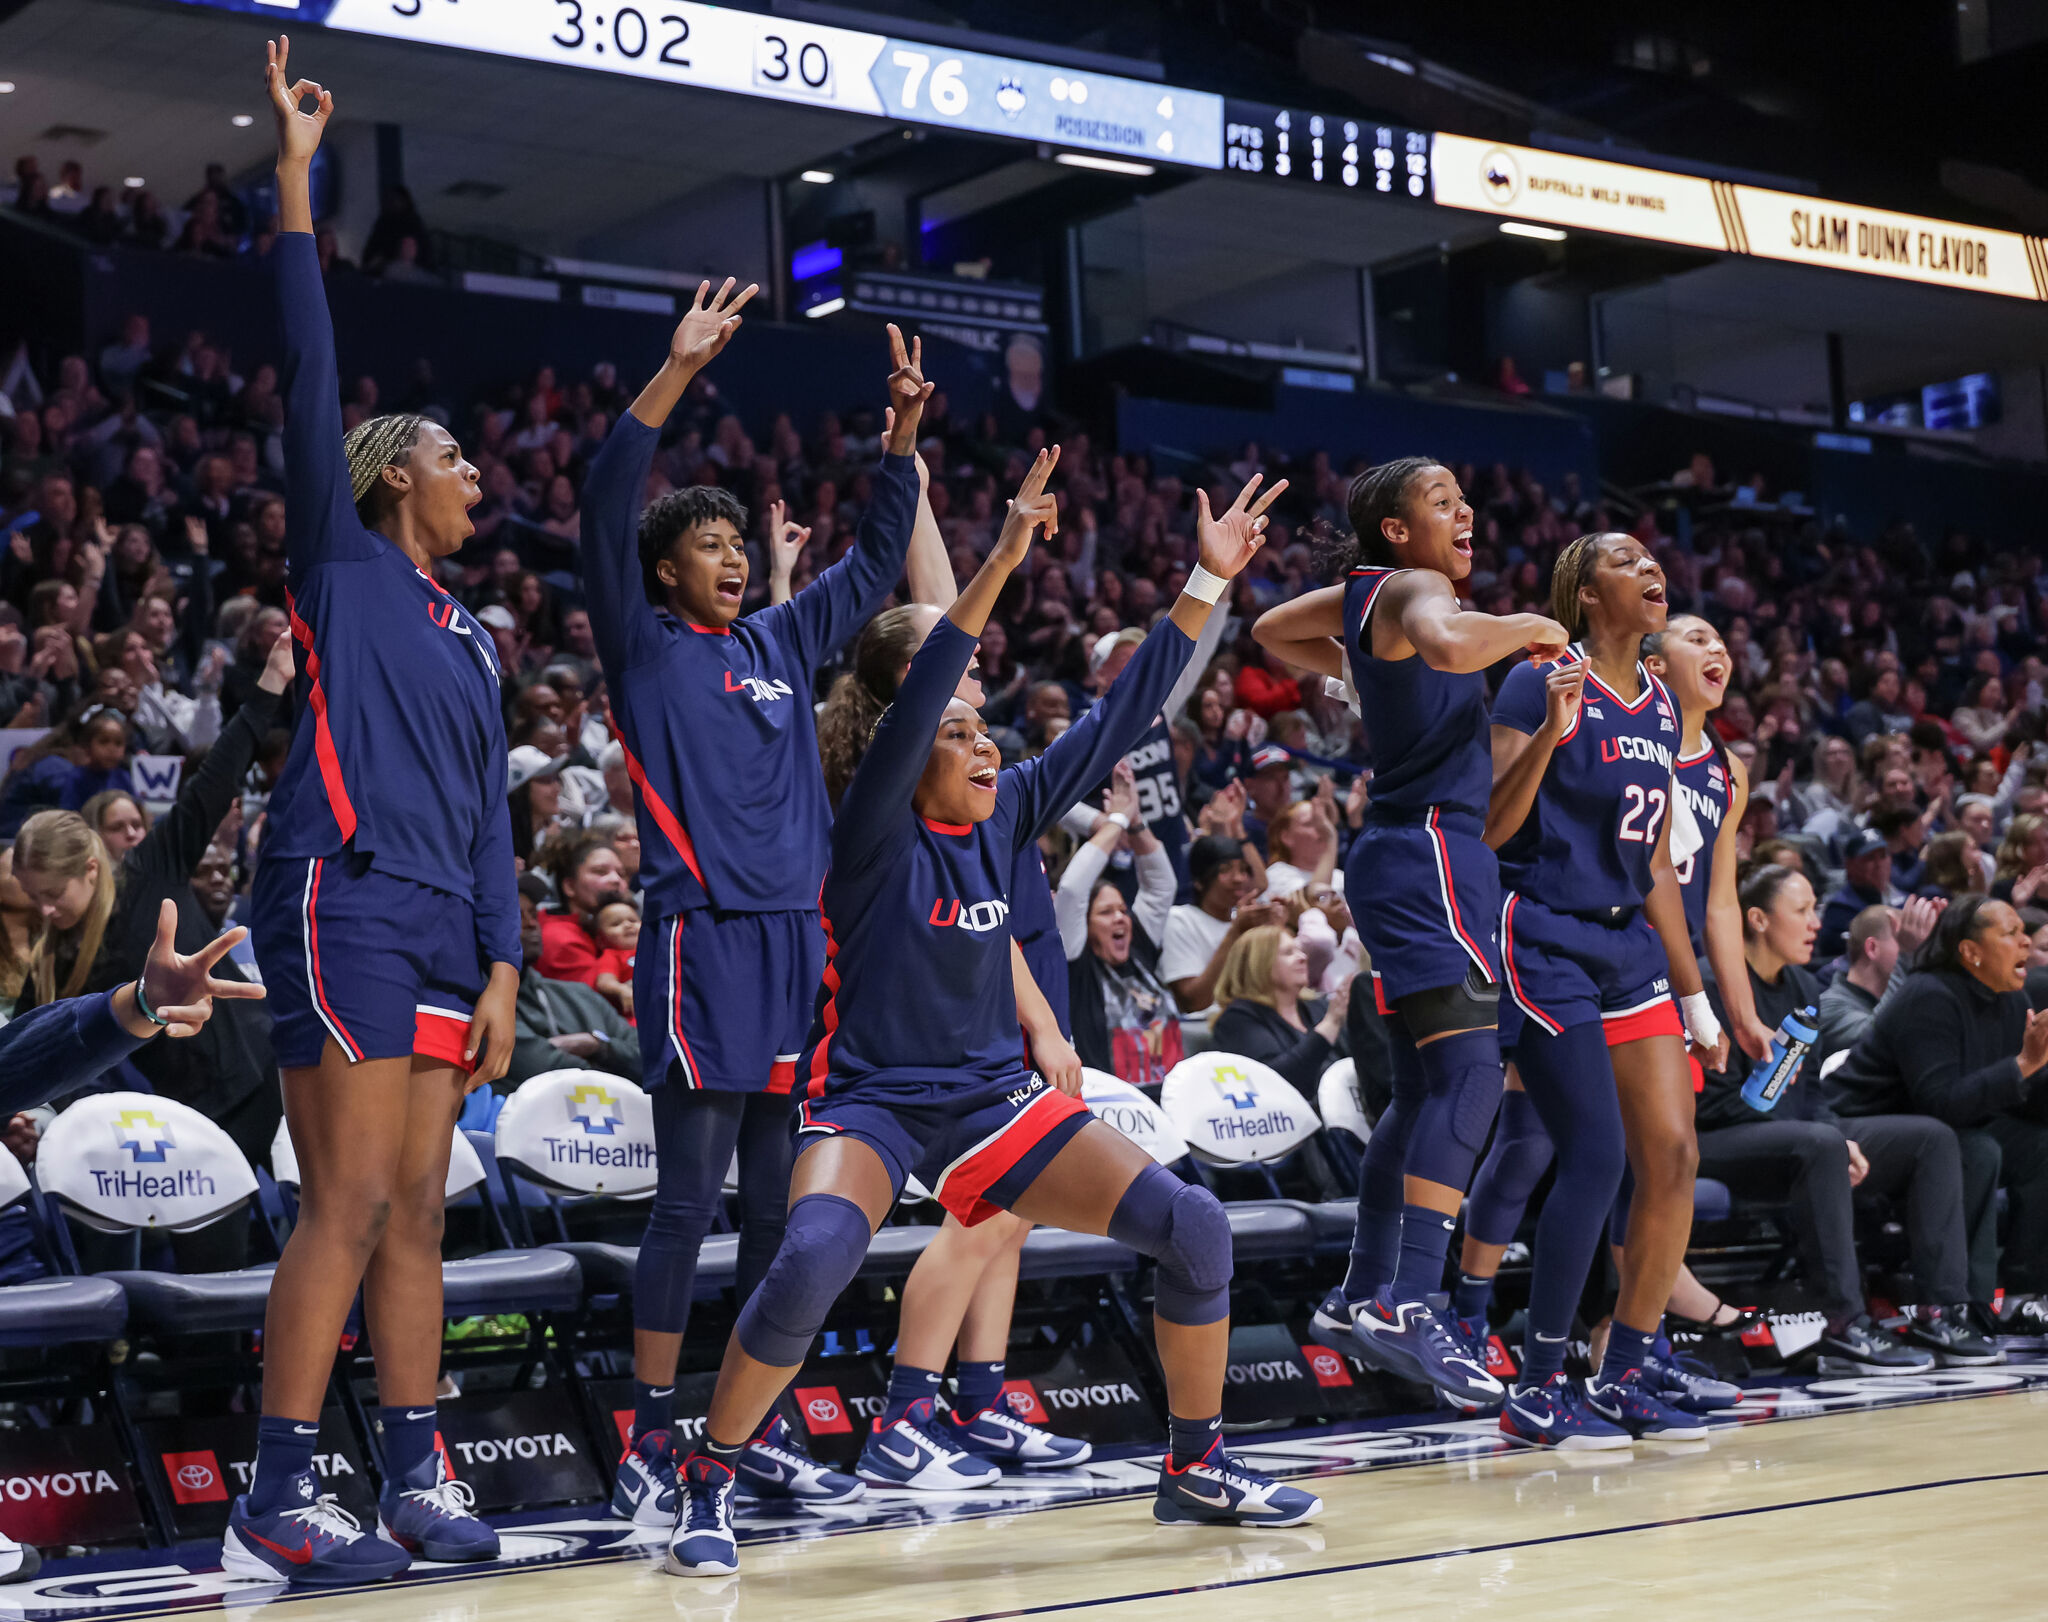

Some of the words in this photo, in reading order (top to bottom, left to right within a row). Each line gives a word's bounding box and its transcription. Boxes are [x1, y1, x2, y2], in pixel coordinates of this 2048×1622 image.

[552, 0, 690, 67] 3:02
[762, 36, 828, 88] 30
[893, 50, 969, 116] 76
[1227, 123, 1264, 149] PTS
[1228, 146, 1264, 173] FLS
[1528, 176, 1584, 198] BUFFALO
[1591, 187, 1620, 204] WILD
[1627, 192, 1666, 213] WINGS
[1790, 210, 1848, 254] SLAM
[1858, 222, 1910, 265] DUNK
[1919, 231, 1988, 278] FLAVOR
[1600, 735, 1673, 776] UCONN
[137, 761, 176, 790] W
[1136, 771, 1181, 821] 35
[1619, 783, 1667, 845] 22
[1207, 1110, 1295, 1141] TriHealth
[542, 1136, 657, 1169] TriHealth
[89, 1169, 215, 1198] TriHealth
[1224, 1360, 1303, 1385] OYOTA
[1043, 1383, 1140, 1410] TOYOTA
[455, 1432, 576, 1465] TOYOTA
